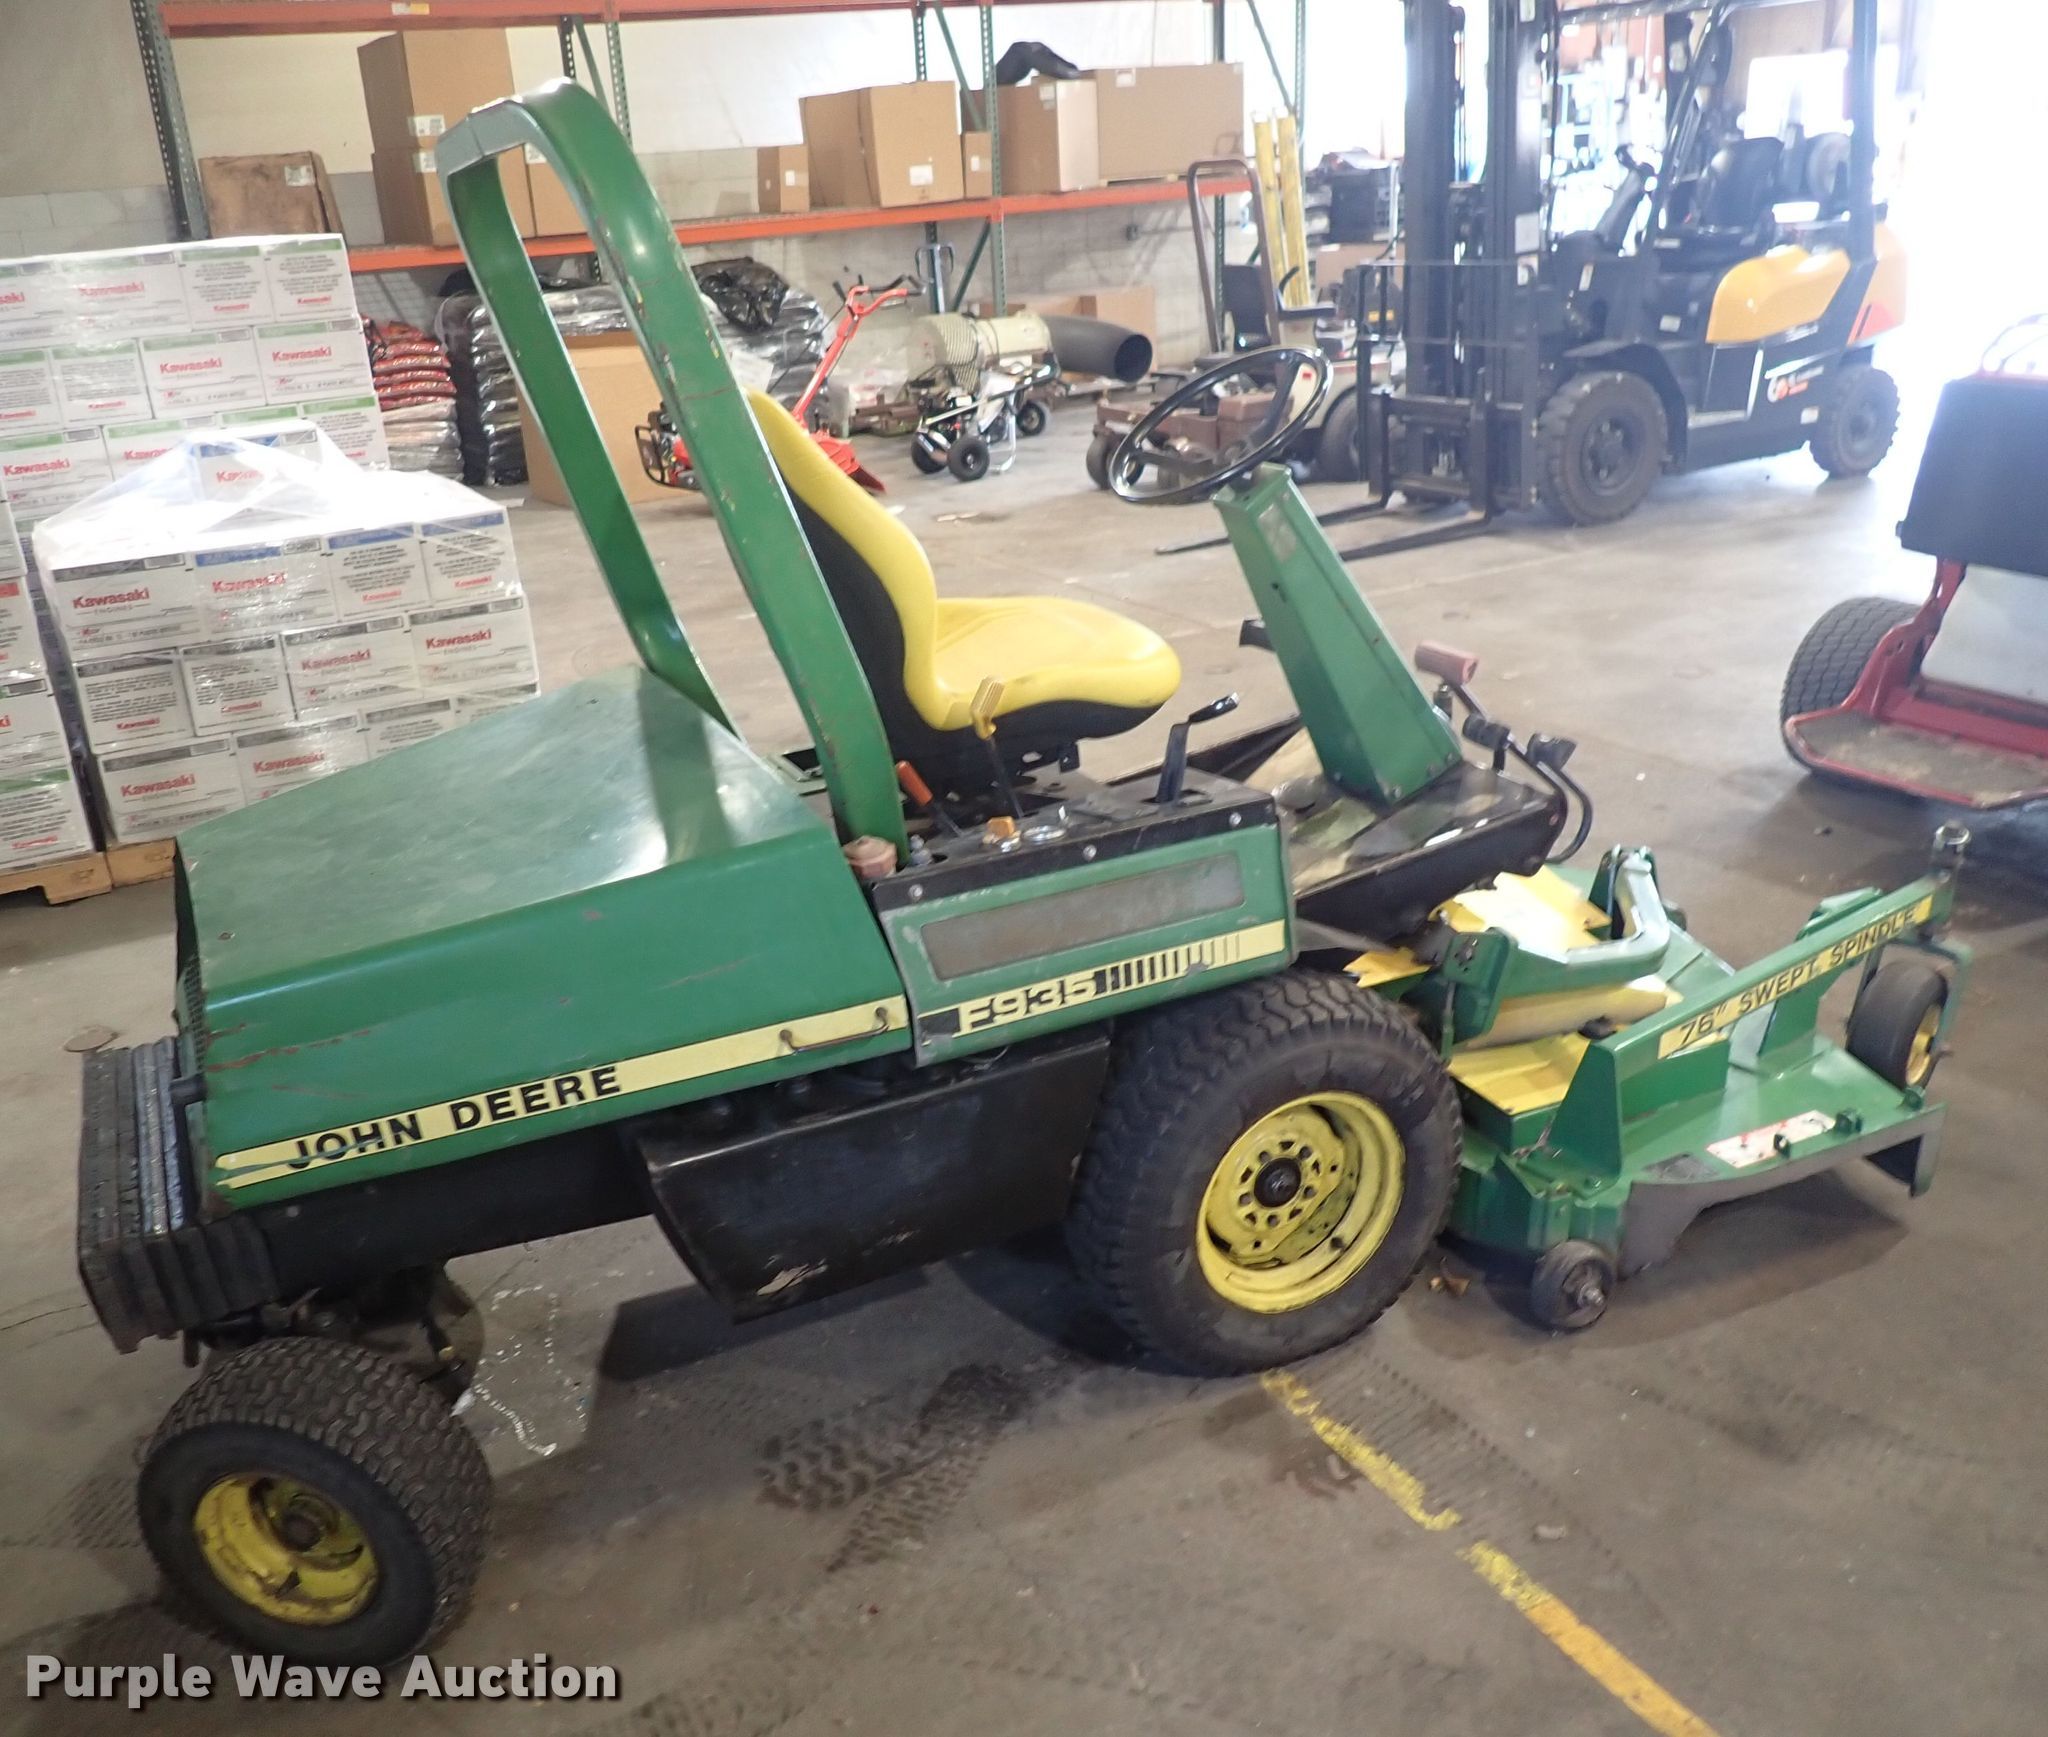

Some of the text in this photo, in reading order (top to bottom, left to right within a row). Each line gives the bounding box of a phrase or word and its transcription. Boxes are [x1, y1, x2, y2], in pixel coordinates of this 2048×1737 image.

[272, 346, 331, 362] Kawasaki
[160, 358, 222, 374] Kawasaki
[3, 458, 70, 477] Kawasaki
[72, 587, 150, 609] Kawasaki
[426, 628, 492, 650] Kawasaki
[301, 649, 371, 671] Kawasaki
[253, 751, 326, 773] Kawasaki
[120, 773, 196, 797] Kawasaki
[1740, 959, 1819, 1014] SWEPT
[957, 972, 1097, 1035] F935
[286, 1065, 621, 1170] JOHN DEERE
